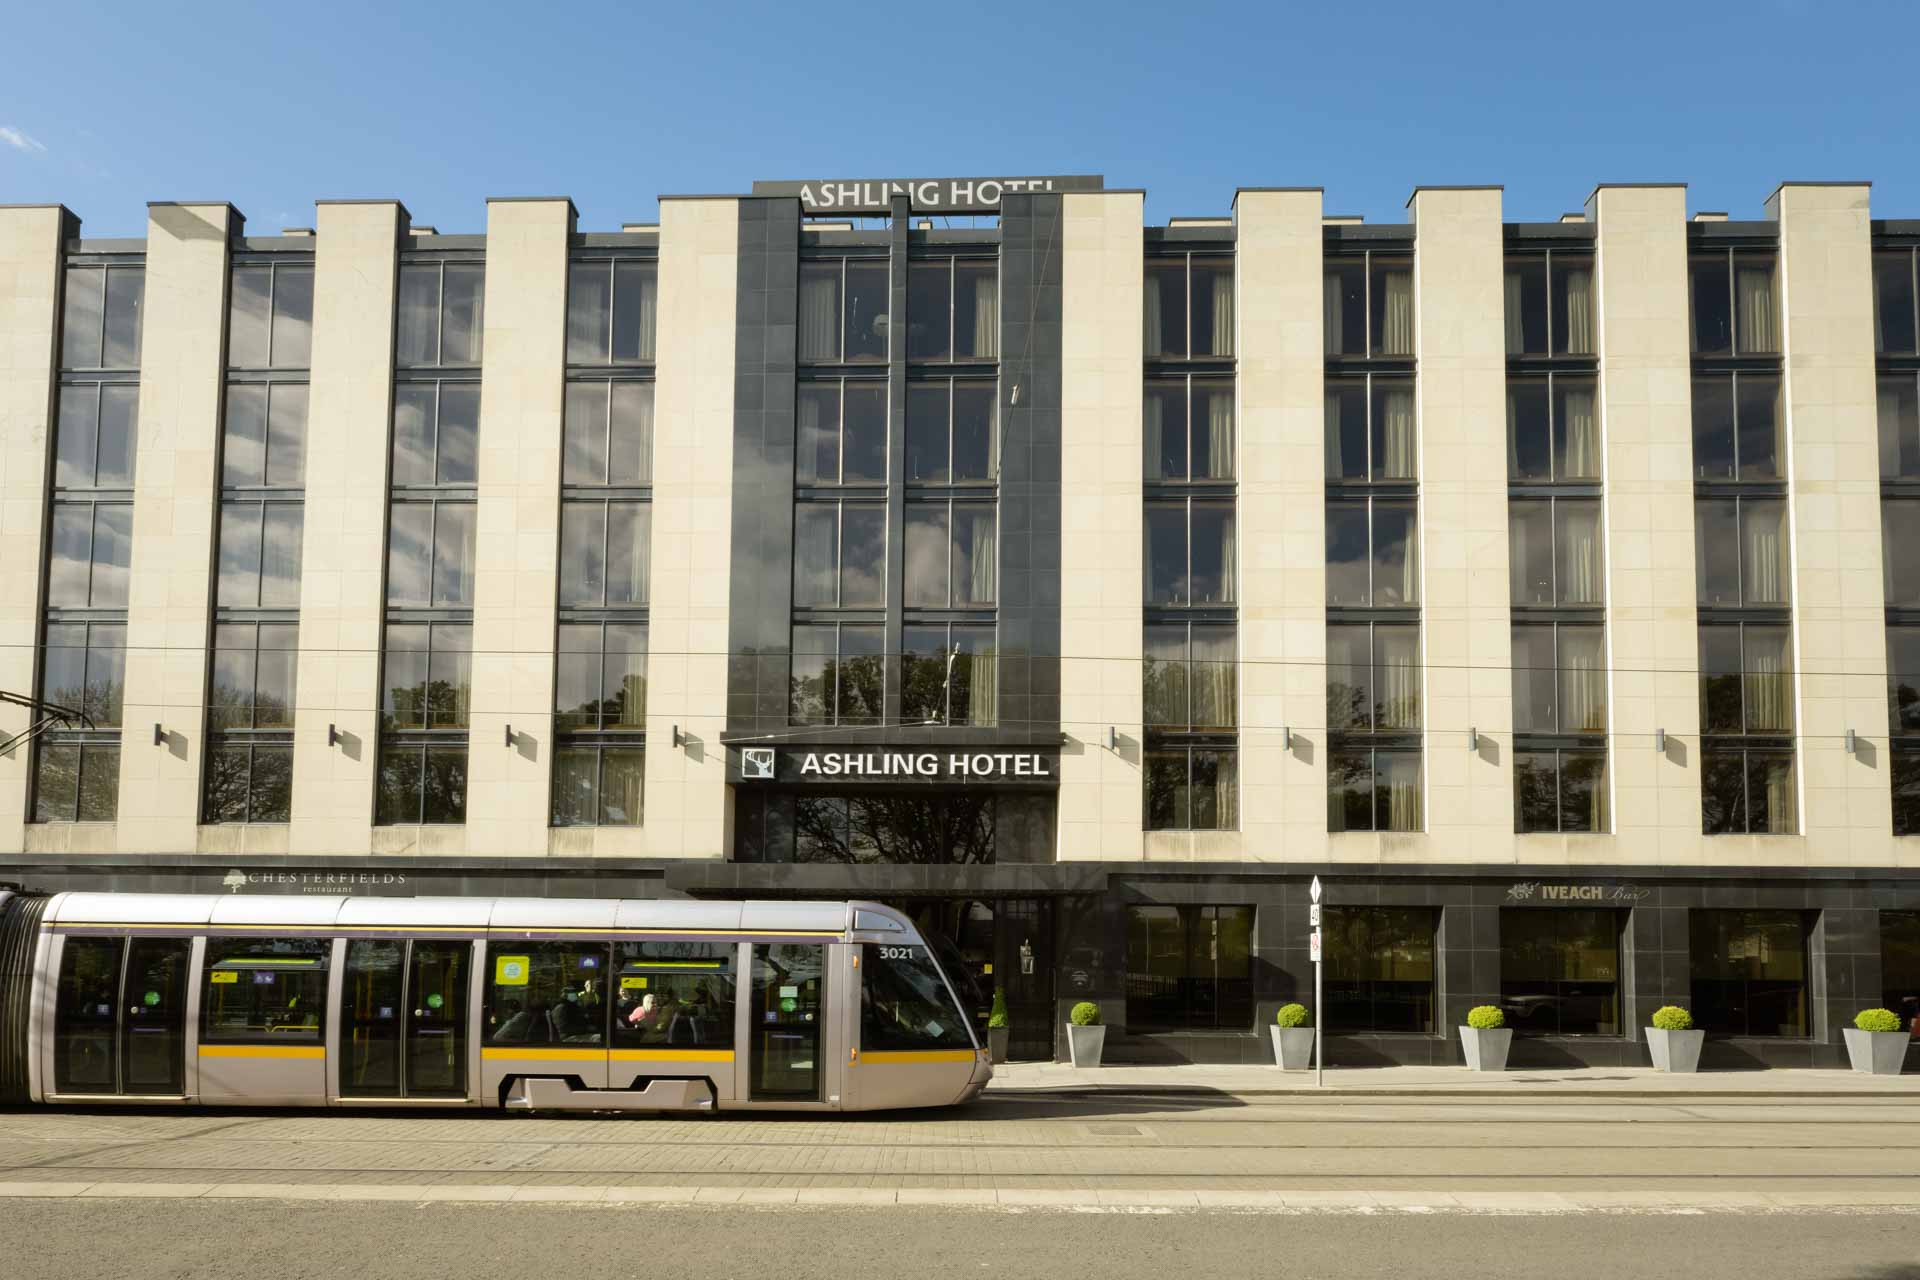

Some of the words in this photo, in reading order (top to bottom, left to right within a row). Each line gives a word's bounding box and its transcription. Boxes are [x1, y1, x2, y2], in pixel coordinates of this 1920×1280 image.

[800, 753, 938, 775] ASHLING
[949, 753, 1049, 775] HOTEL
[249, 873, 406, 884] CHESTERFIELDS
[1542, 886, 1602, 899] IVEAGH
[1605, 884, 1650, 900] Bar
[880, 947, 913, 959] 3021
